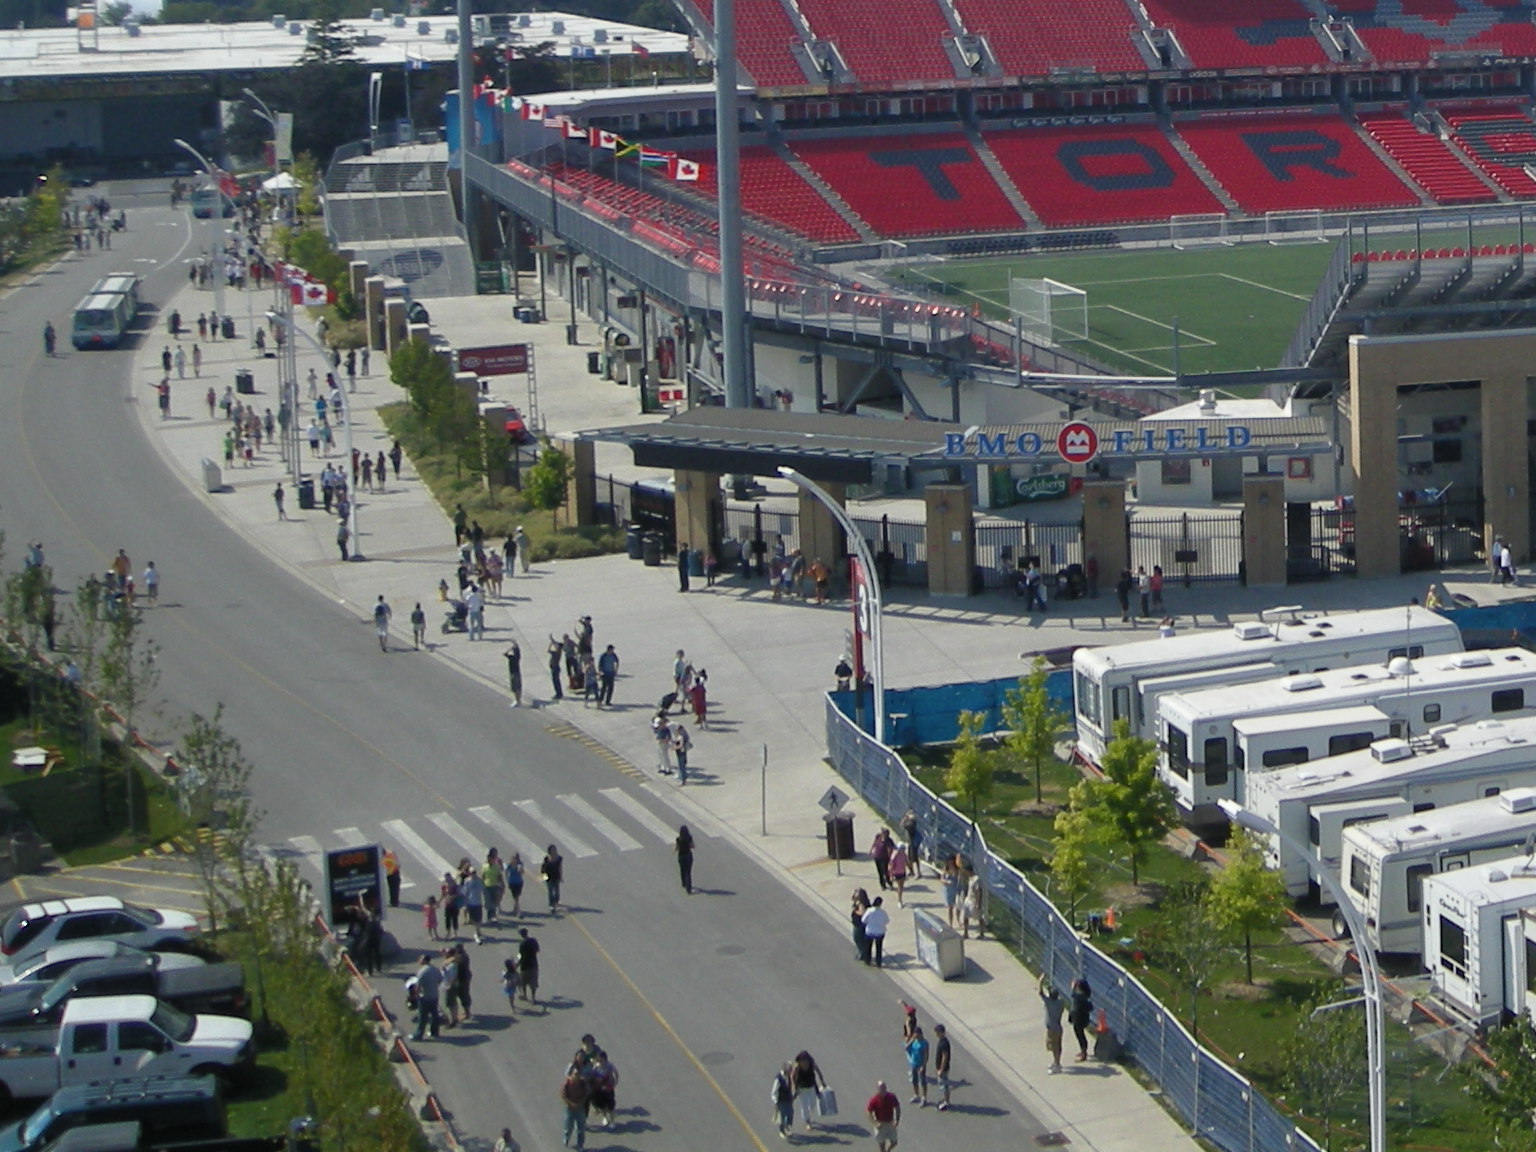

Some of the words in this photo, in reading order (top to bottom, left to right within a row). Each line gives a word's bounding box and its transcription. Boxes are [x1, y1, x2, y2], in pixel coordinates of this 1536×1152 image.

[944, 431, 1042, 457] BMO
[1113, 425, 1252, 453] FIELD
[1016, 479, 1066, 497] Carlsberg
